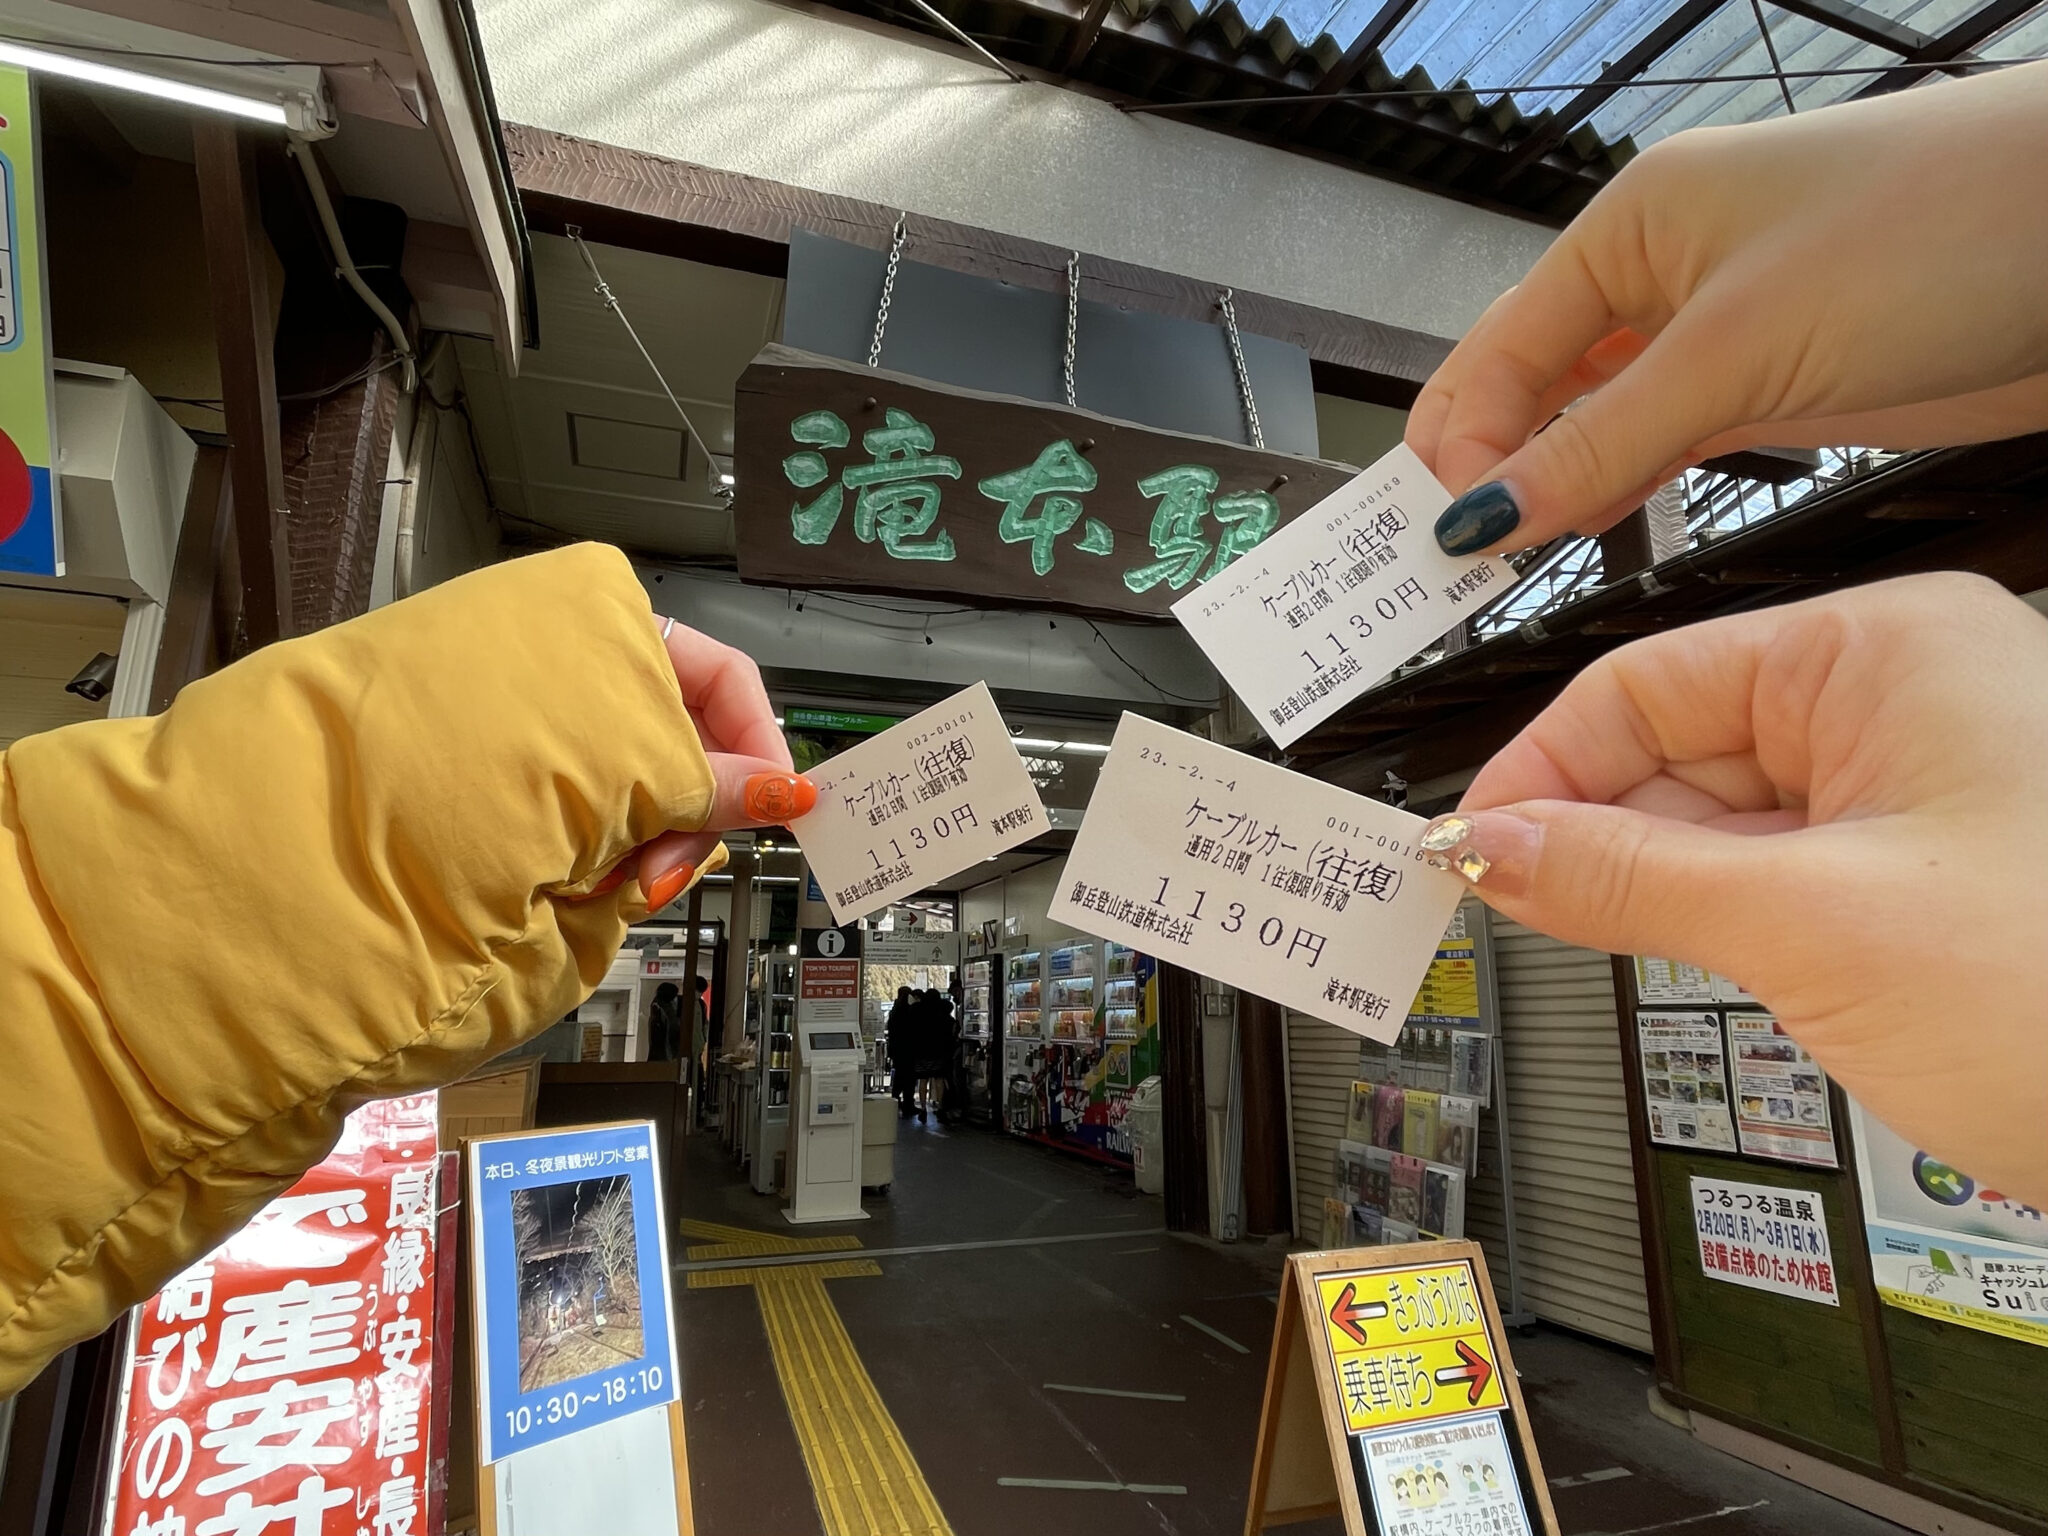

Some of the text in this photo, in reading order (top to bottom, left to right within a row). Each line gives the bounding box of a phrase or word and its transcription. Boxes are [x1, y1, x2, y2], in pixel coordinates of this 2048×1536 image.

[783, 406, 1280, 593] 滝本駅
[1442, 560, 1496, 606] 滝本駅発行
[1300, 576, 1429, 673] 1130円
[1269, 655, 1363, 727] 御岳登山鉄道株式会社
[907, 711, 975, 750] 002-00101
[866, 803, 979, 871] 1130円
[990, 804, 1034, 837] 滝本駅発行
[835, 860, 914, 908] 御岳登山鉄道株式会社
[1069, 880, 1195, 947] 御岳登山鉄道株式会社
[1149, 875, 1329, 970] 1130円
[1322, 975, 1391, 1022] 滝本駅発行
[484, 1144, 650, 1181] 本日、冬夜景観光リフト営業
[1698, 1188, 1816, 1223] つるつる温泉
[1701, 1239, 1835, 1295] 設備点検のため休館
[1342, 1351, 1433, 1416] 乗車待ち
